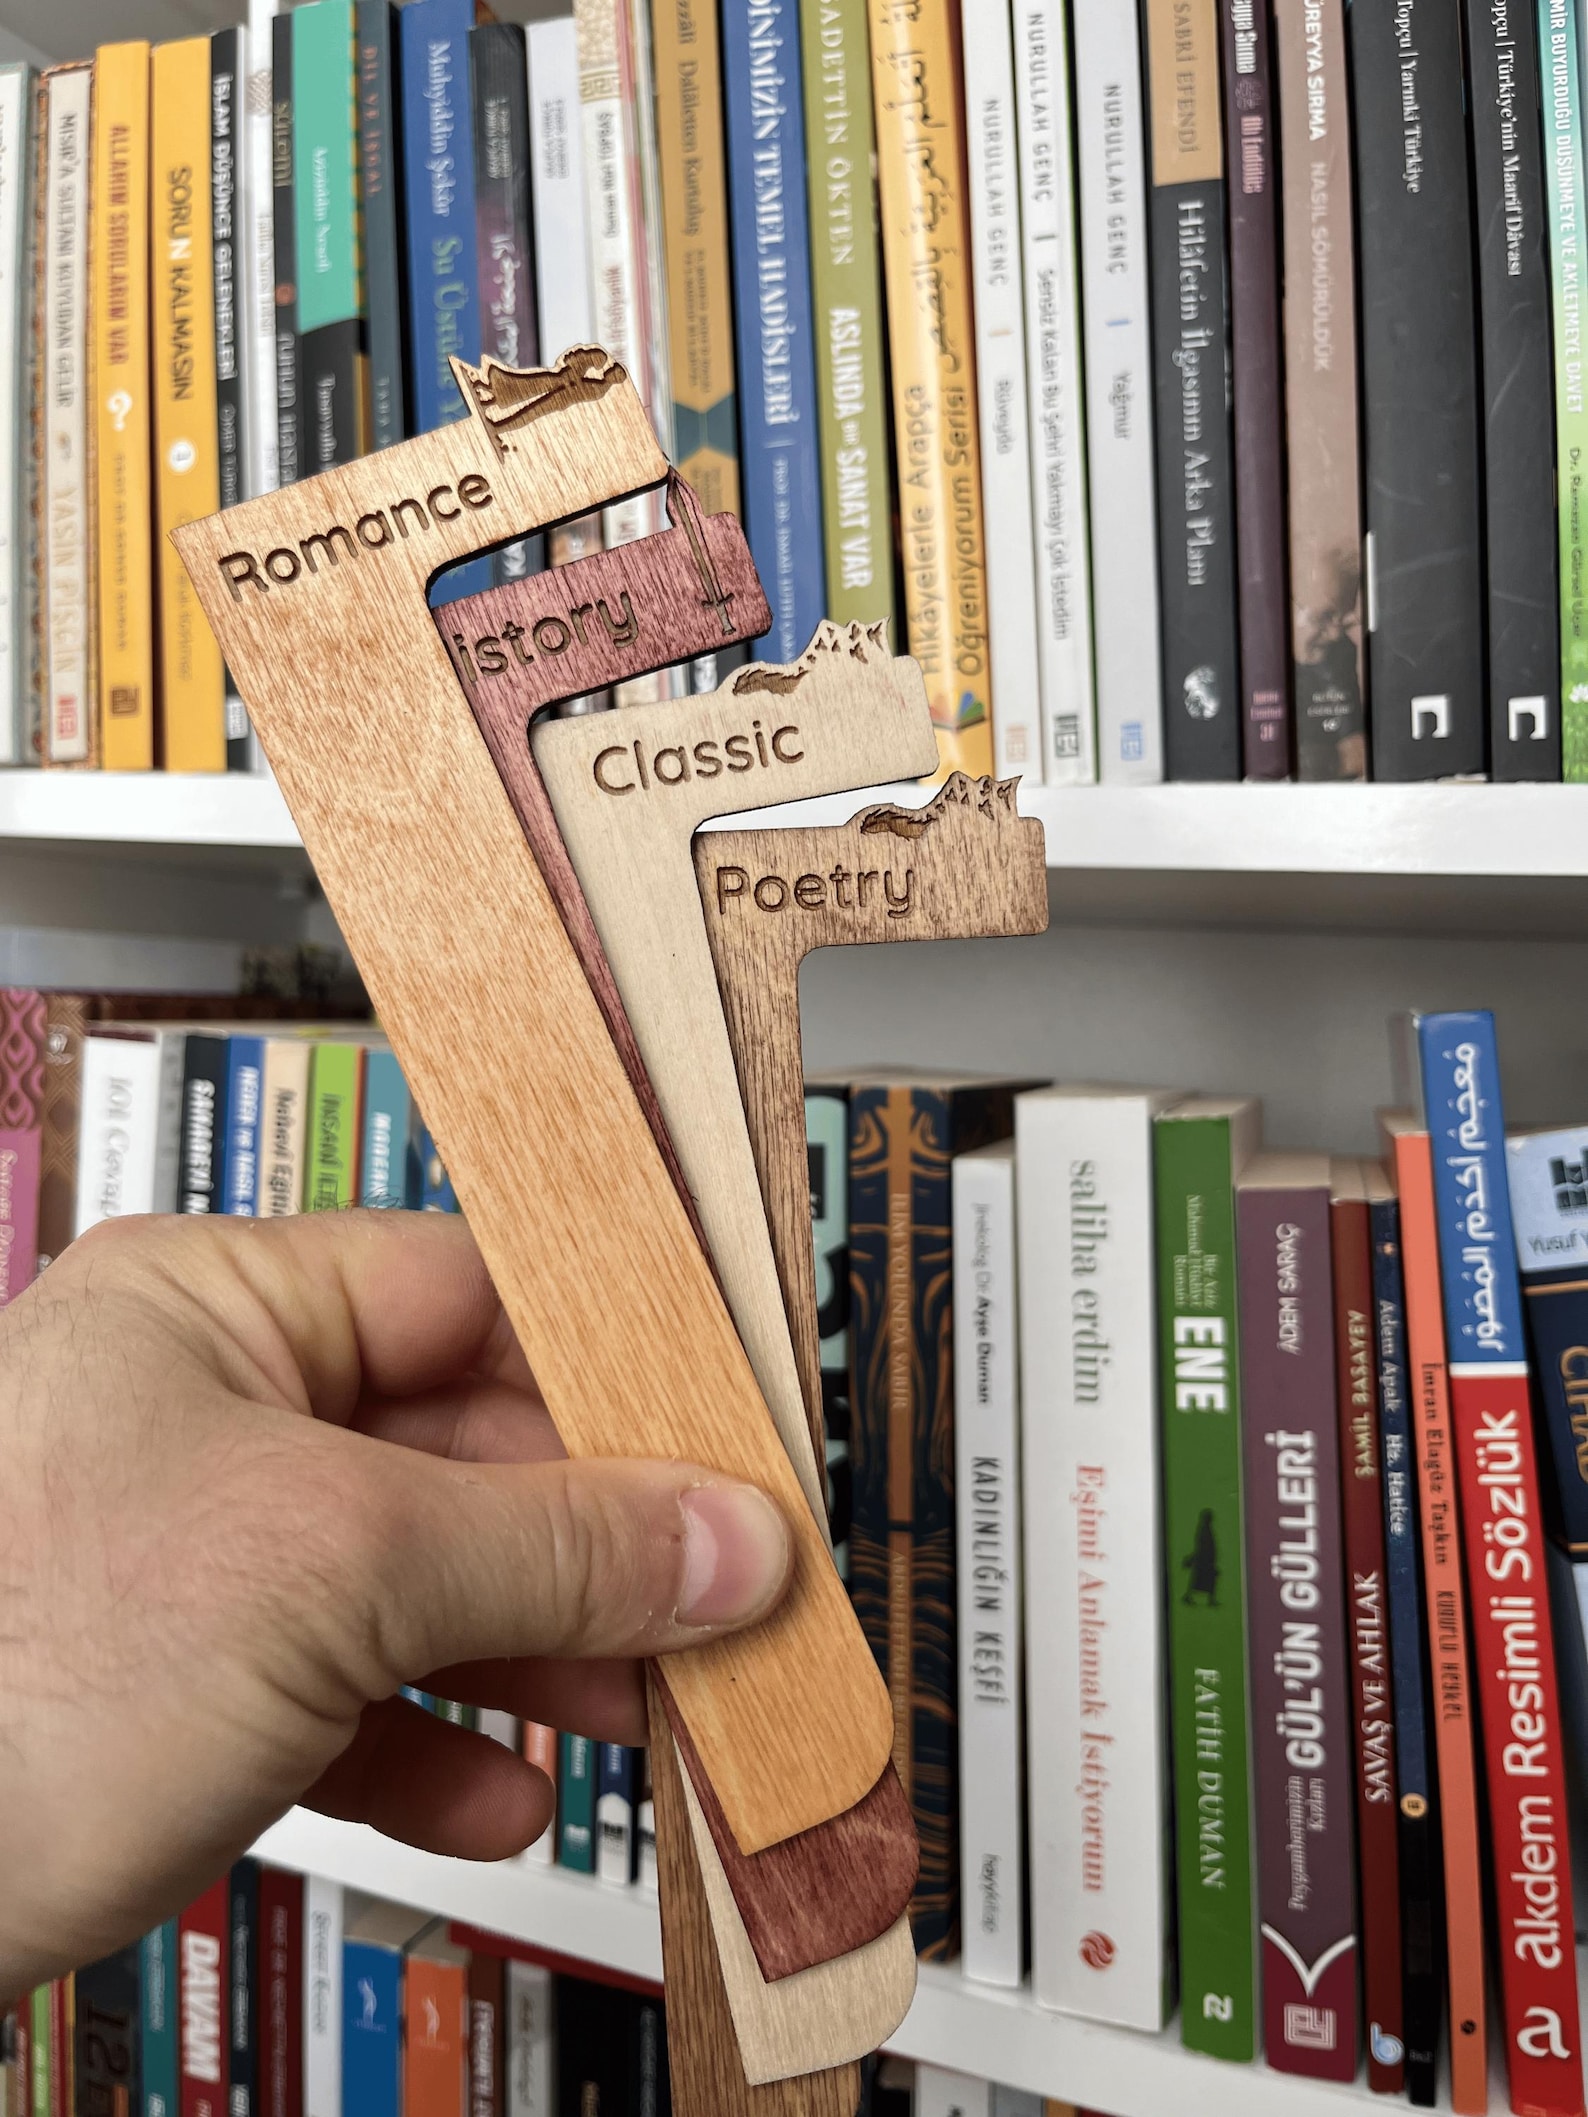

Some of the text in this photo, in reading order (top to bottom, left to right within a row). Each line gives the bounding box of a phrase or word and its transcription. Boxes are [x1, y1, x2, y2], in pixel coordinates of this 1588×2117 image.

[1489, 0, 1508, 38] opçu
[1548, 0, 1568, 30] MİR
[422, 41, 452, 155] Muhyiddin
[1026, 13, 1053, 203] NURULLAH GENÇ
[1171, 2, 1201, 154] SABRİ EFENDİ
[1392, 0, 1424, 195] Topçu Yarınki Türkiye
[1549, 33, 1573, 131] BUYURDUĞU
[210, 73, 239, 381] İSLAM DÜŞÜNCE GELENEKLERİ
[751, 143, 784, 255] TEMEL
[825, 156, 855, 266] ÖKTEN
[981, 100, 1008, 288] NURULLAH GENÇ
[1102, 85, 1127, 277] NURULLAH GENÇ
[1302, 0, 1335, 373] ÜREYYA SIRMA NASIL SÖMÜRÜLDÜK
[1501, 154, 1522, 215] Maarif
[1554, 134, 1579, 233] DÜŞÜNMEYE
[167, 165, 194, 402] SORUN KALMASIN
[431, 236, 461, 276] Su
[1035, 269, 1058, 327] Sensiz
[1504, 214, 1525, 277] Dâvası
[1559, 234, 1577, 259] VE
[756, 256, 799, 426] HADİSLERİ
[827, 307, 865, 421] ASLINDA
[1041, 330, 1062, 382] Kalan
[1564, 361, 1584, 415] DAVET
[834, 446, 871, 530] SANAT
[903, 383, 936, 489] Arapça
[1182, 449, 1213, 512] Arka
[217, 471, 494, 604] Romance
[942, 384, 988, 677] Öğreniyorum Serisi
[1043, 462, 1066, 538] Yakmayı
[1183, 515, 1216, 586] Planı
[838, 533, 873, 591] VAR
[452, 588, 640, 684] istory
[592, 718, 805, 798] Classic
[716, 861, 916, 919] Poetry
[1068, 1159, 1113, 1407] saliha erdim
[1274, 1220, 1303, 1356] ADEM SARAÇ
[1527, 1229, 1578, 1257] Yusuf
[973, 1293, 994, 1339] Ayşe
[1172, 1315, 1230, 1414] ENE
[1377, 1299, 1401, 1413] Adem Apak
[975, 1341, 992, 1404] Duman
[1346, 1310, 1376, 1479] ŞAMİL BASAYEV
[1387, 1471, 1408, 1536] Hatice
[1418, 1363, 1451, 1566] İmran Elagöz Taşkın
[966, 1455, 1009, 1705] KADINLIĞIN KEŞFİ
[1263, 1429, 1326, 1768] GÜL'ÜN GÜLLERİ
[1068, 1463, 1114, 1895] Eşimi Anlamak İstiyorum
[1352, 1571, 1393, 1803] SAVAŞ VE AHLAK
[1472, 1409, 1563, 1969] akdem Resimli Sözlük
[1192, 1667, 1227, 1890] FATİH DUMAN
[179, 1929, 221, 2084] DAVAM
